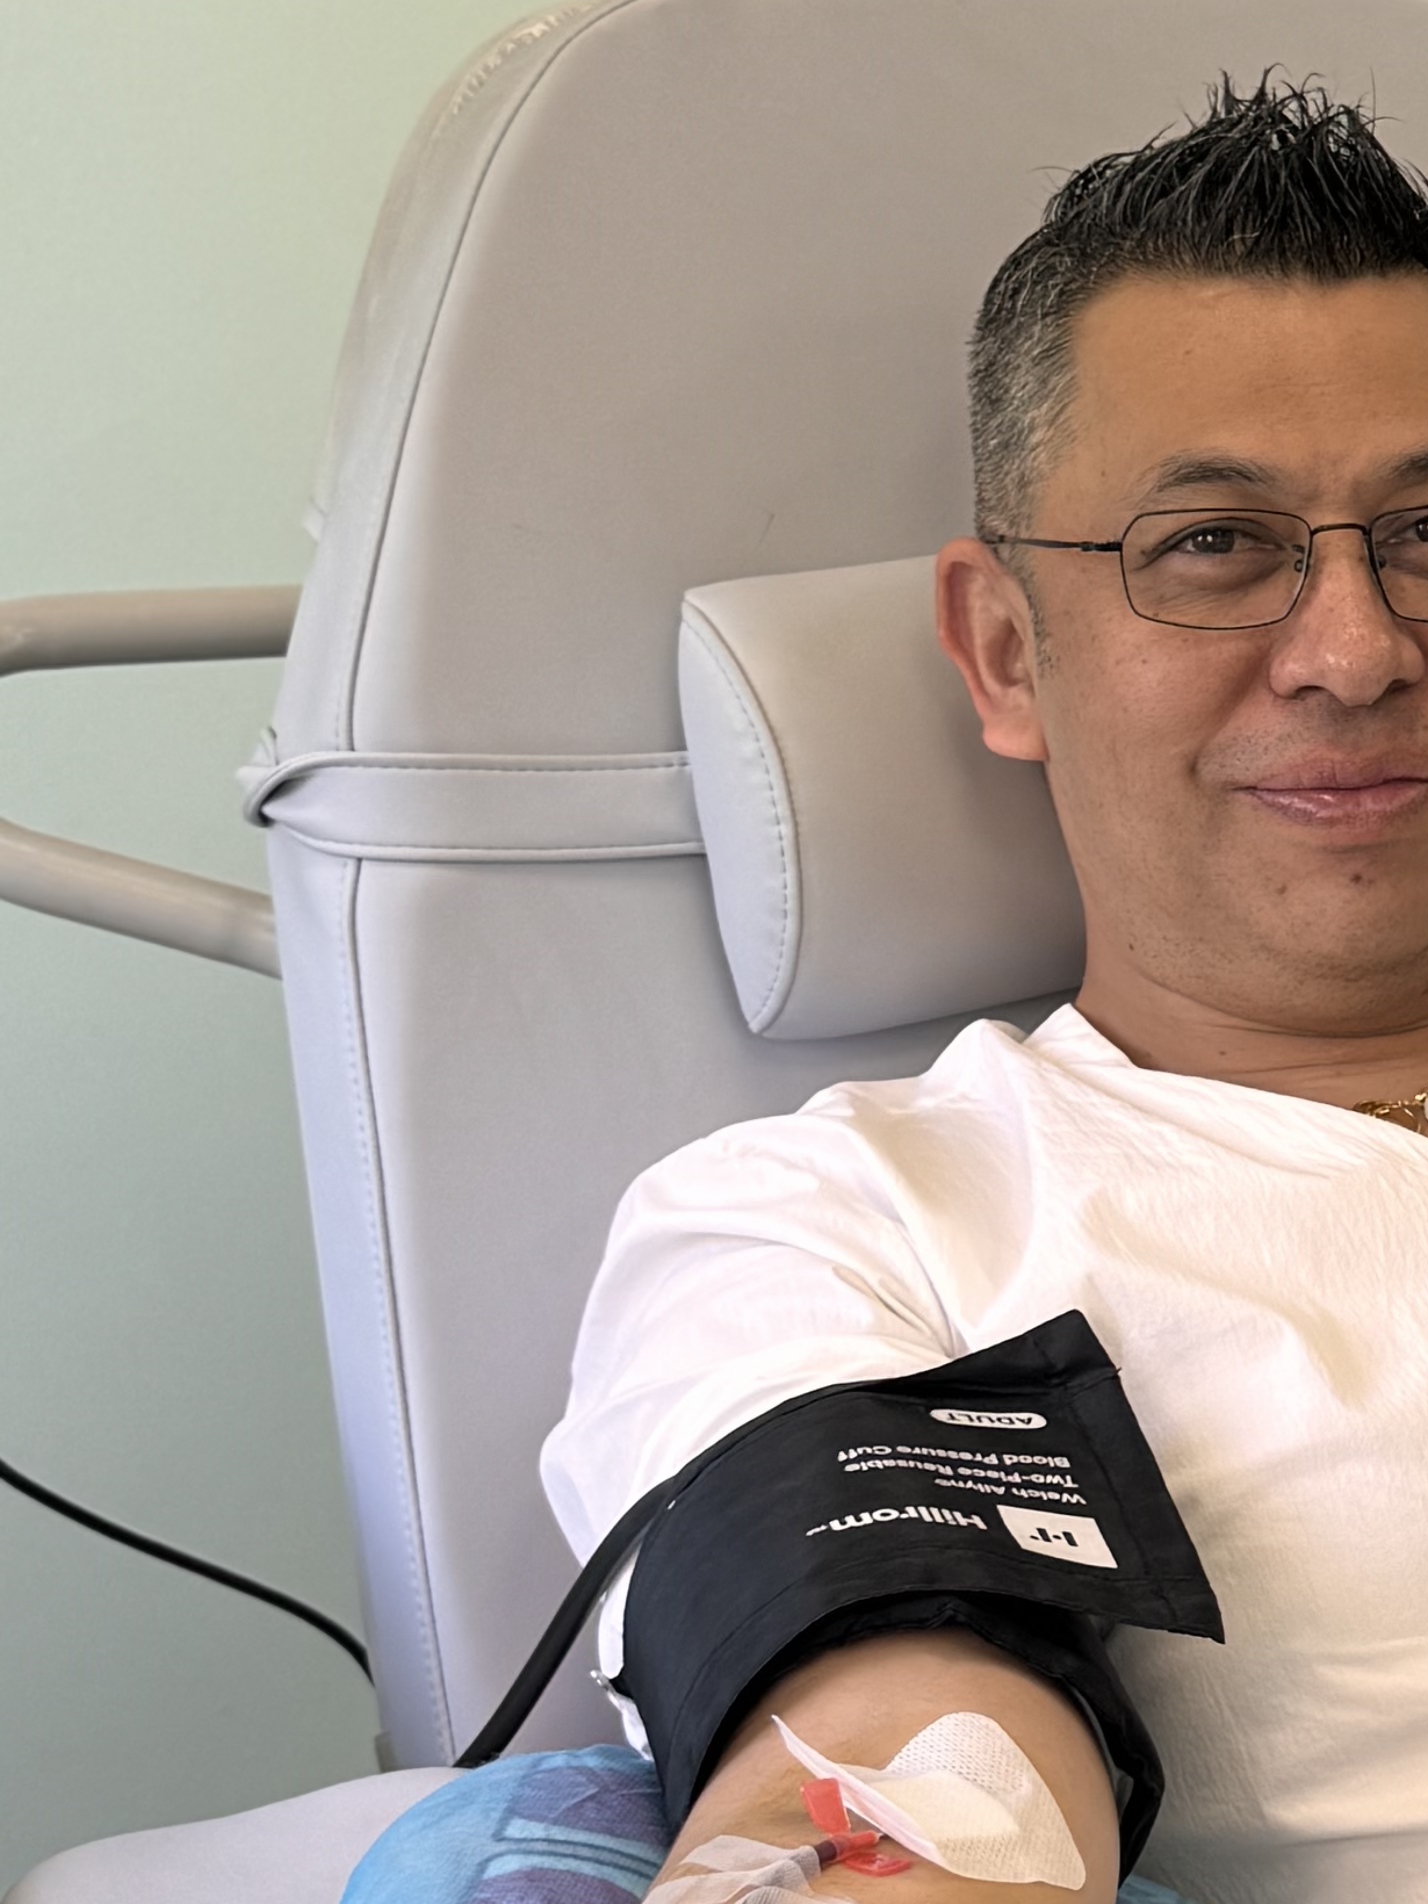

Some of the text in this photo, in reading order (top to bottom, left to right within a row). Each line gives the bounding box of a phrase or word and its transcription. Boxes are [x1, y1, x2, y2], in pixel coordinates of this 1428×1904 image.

[944, 1411, 1034, 1428] ADULT
[838, 1445, 1071, 1468] Blood Pressure Cuff
[844, 1461, 1079, 1488] Two-Piece Reusable
[1008, 1488, 1087, 1505] Welch
[829, 1505, 988, 1532] Hillrom
